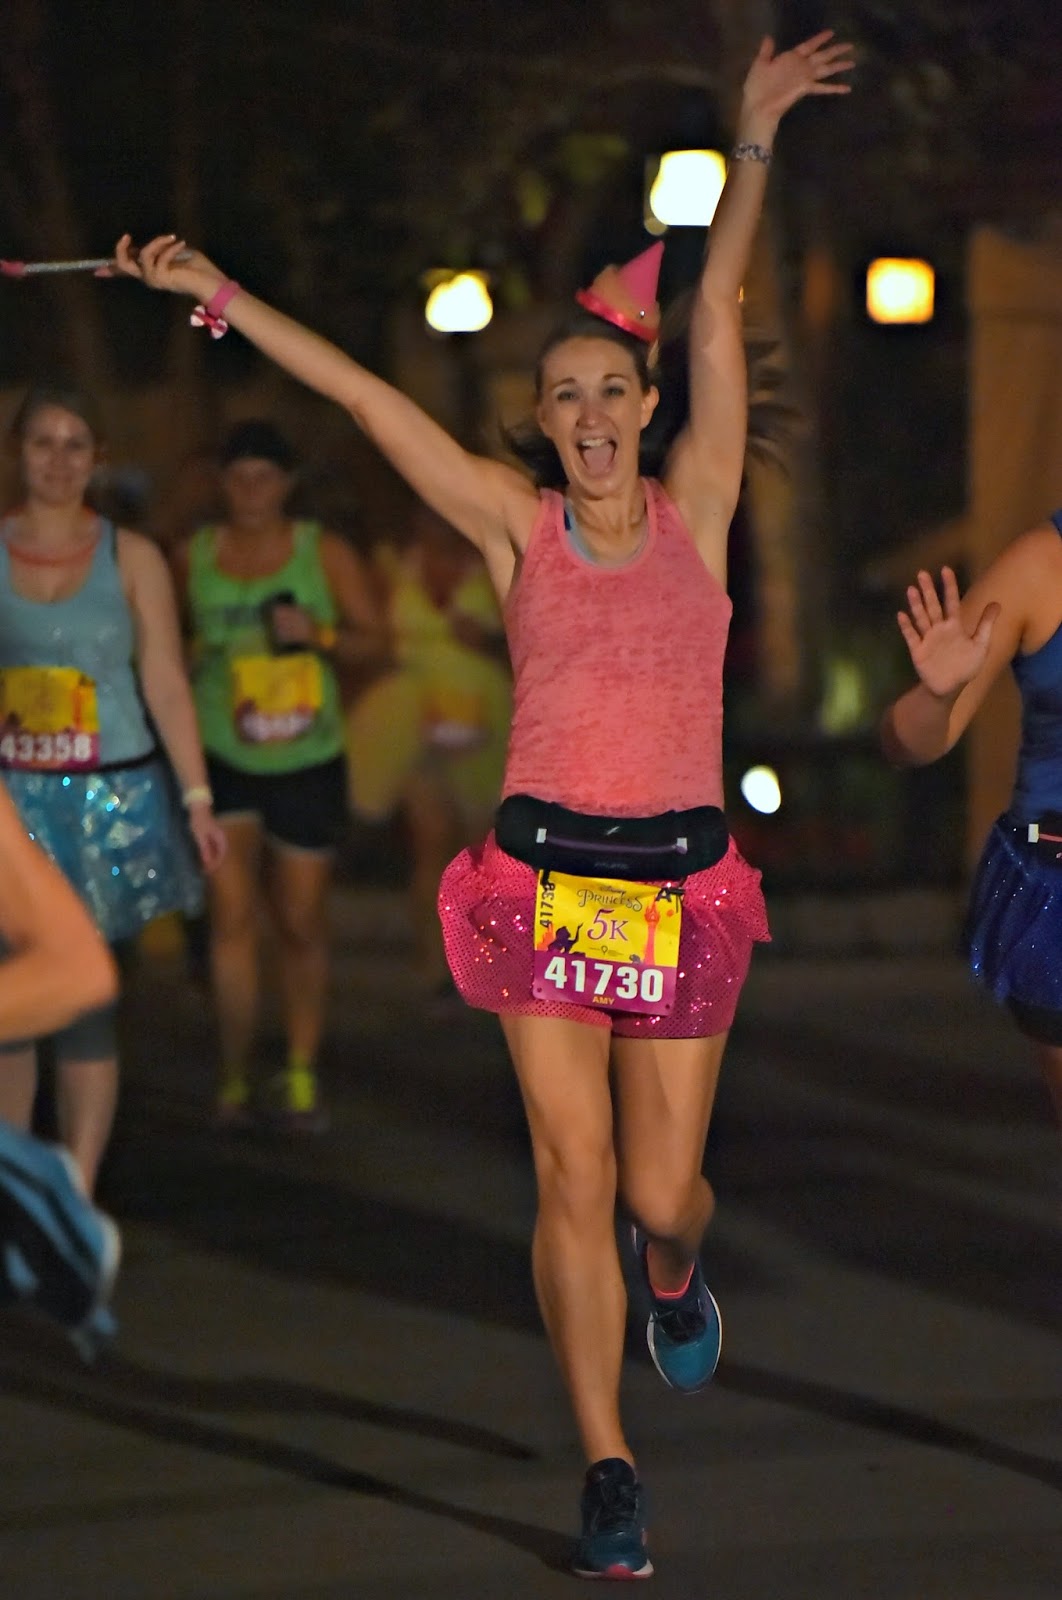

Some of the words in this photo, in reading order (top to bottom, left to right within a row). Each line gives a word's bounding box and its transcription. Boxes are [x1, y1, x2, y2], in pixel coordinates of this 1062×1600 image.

[587, 908, 628, 942] 5K
[543, 955, 664, 1003] 41730
[592, 995, 615, 1005] AMY
